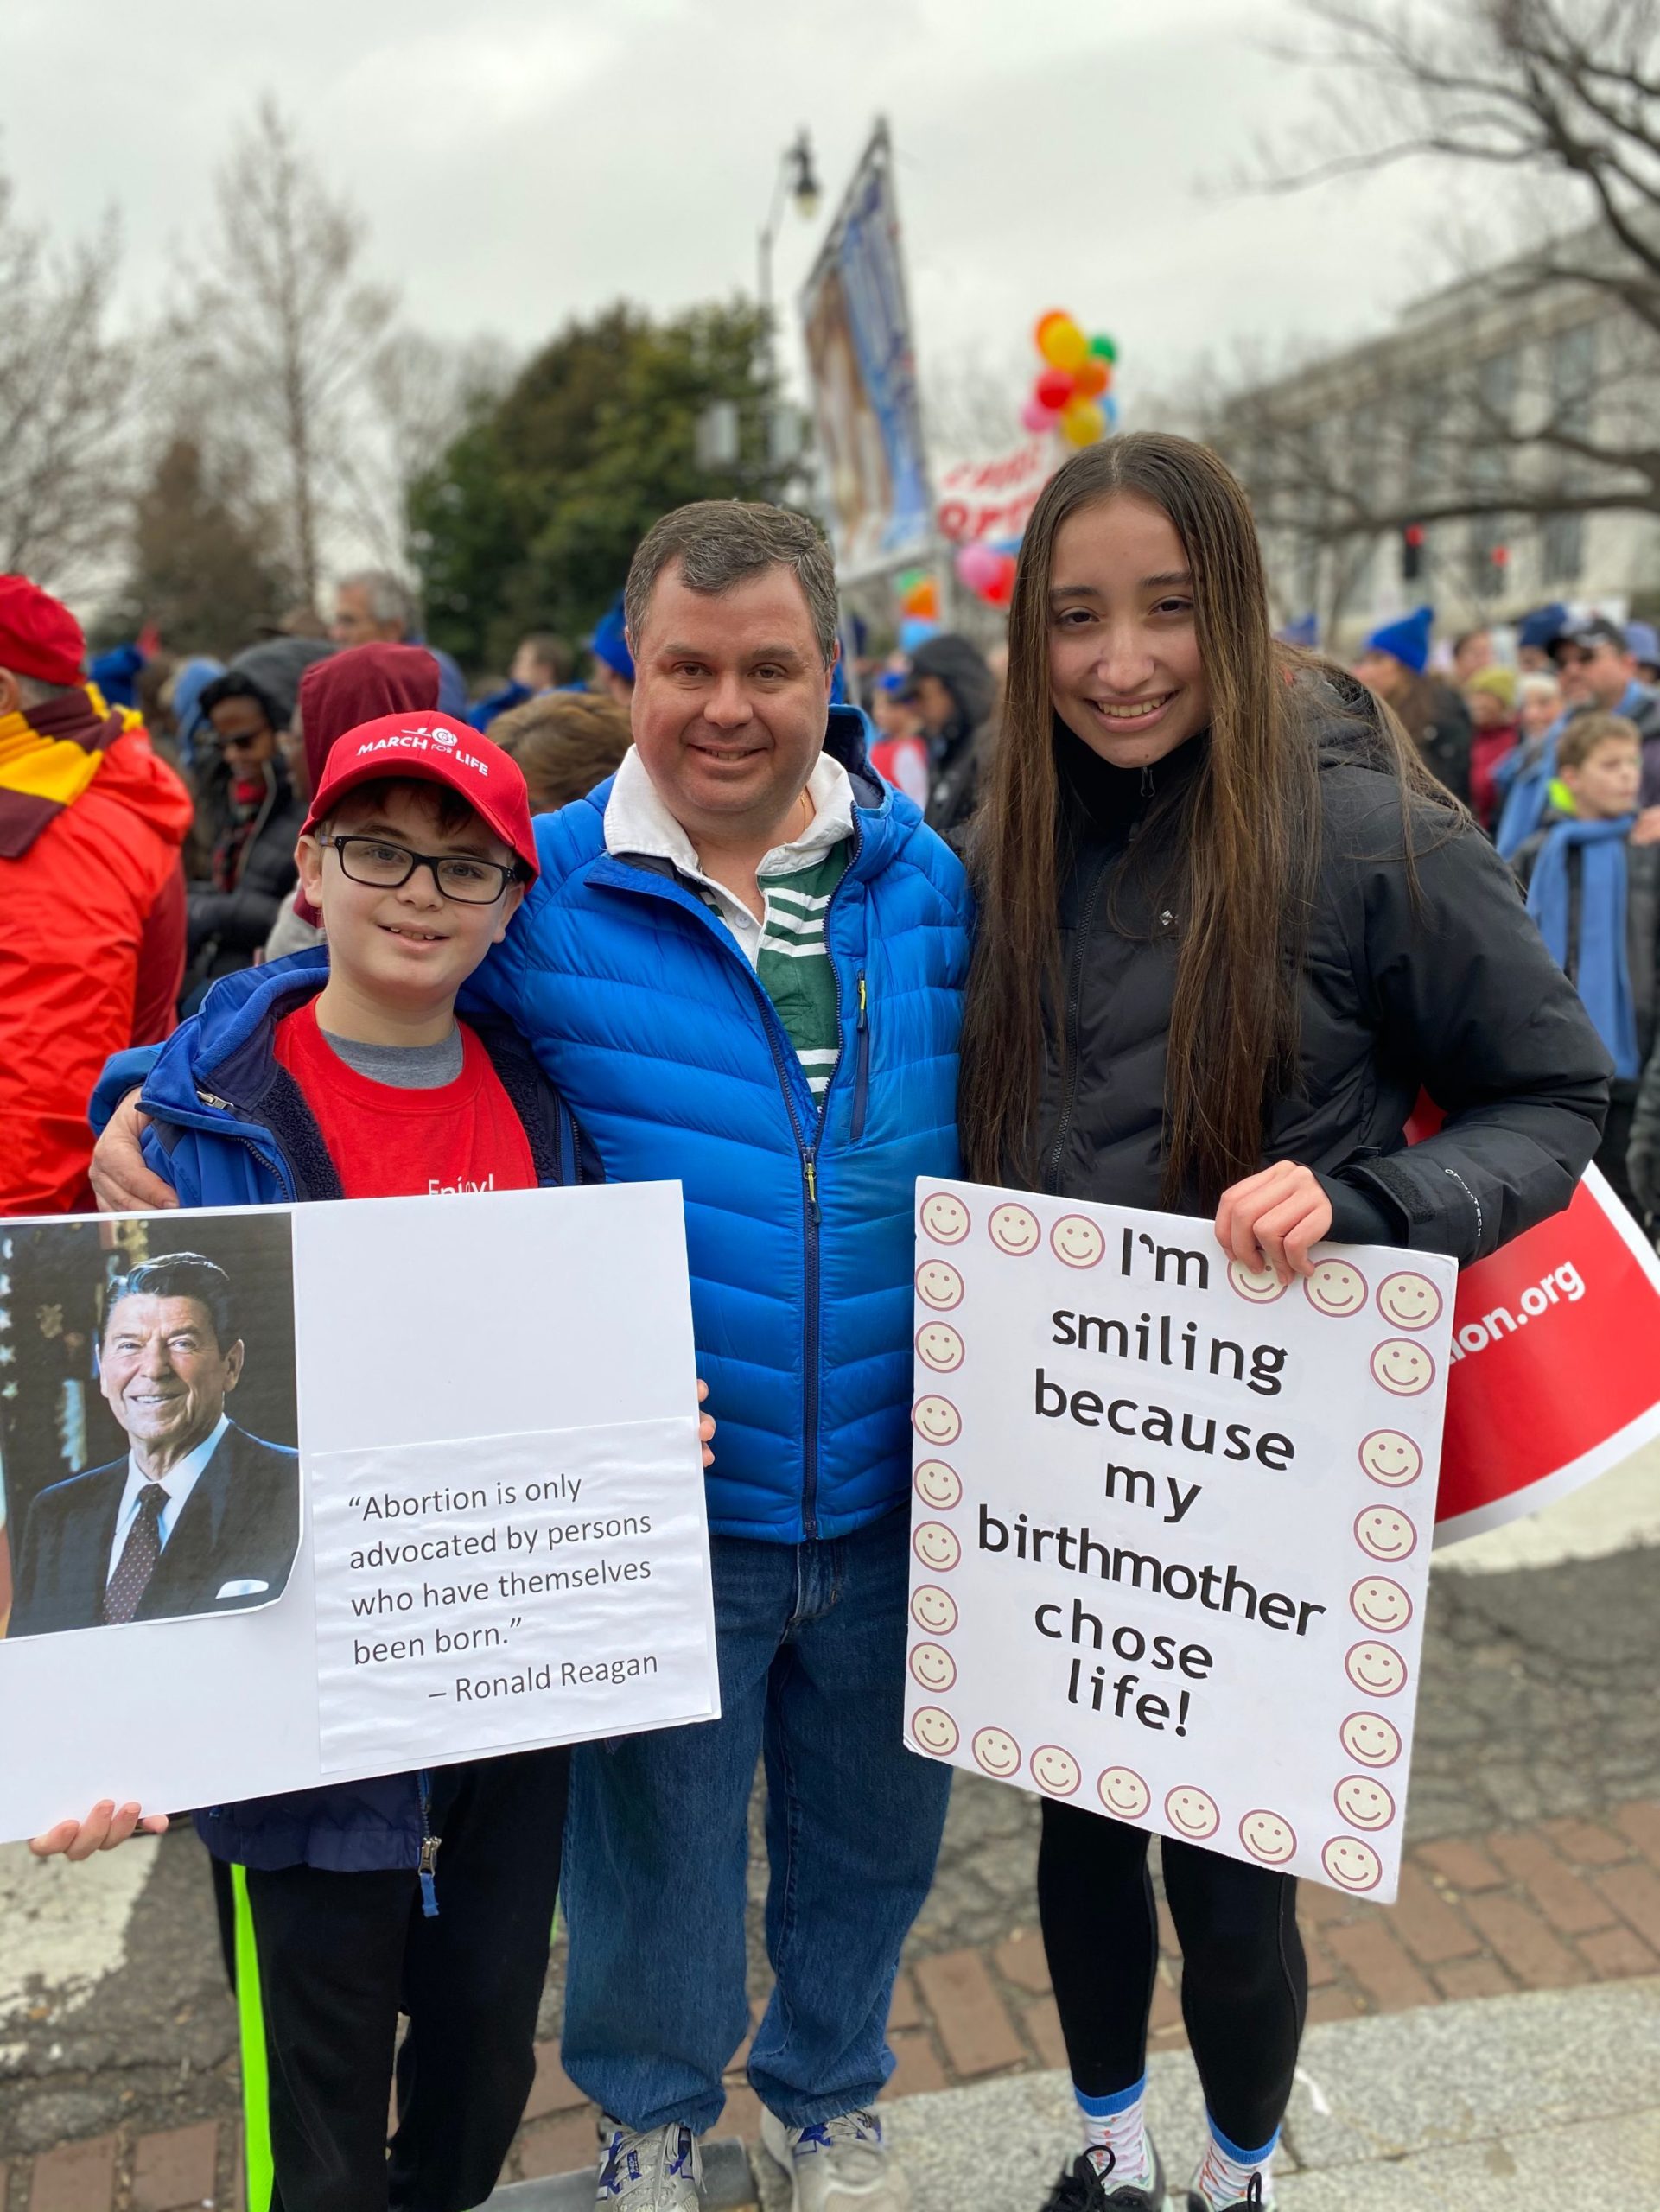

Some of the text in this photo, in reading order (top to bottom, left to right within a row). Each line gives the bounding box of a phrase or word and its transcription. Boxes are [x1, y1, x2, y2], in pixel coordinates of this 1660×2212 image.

[356, 736, 490, 777] MARCH FOR LIFE
[1121, 1227, 1209, 1290] I'm
[1449, 1260, 1587, 1365] ion.org
[1052, 1310, 1288, 1396] smiling
[1035, 1368, 1295, 1471] because
[348, 1473, 582, 1521] “Abortion is only
[1105, 1463, 1202, 1523] my
[349, 1515, 652, 1570] advocated by persons
[979, 1503, 1326, 1638] birthmother
[351, 1560, 652, 1617] who have themselves
[353, 1617, 522, 1665] been born.”
[1034, 1598, 1213, 1680] chose
[455, 1664, 551, 1703] Ronald
[561, 1655, 658, 1687] Reagan
[1068, 1658, 1190, 1738] life!
